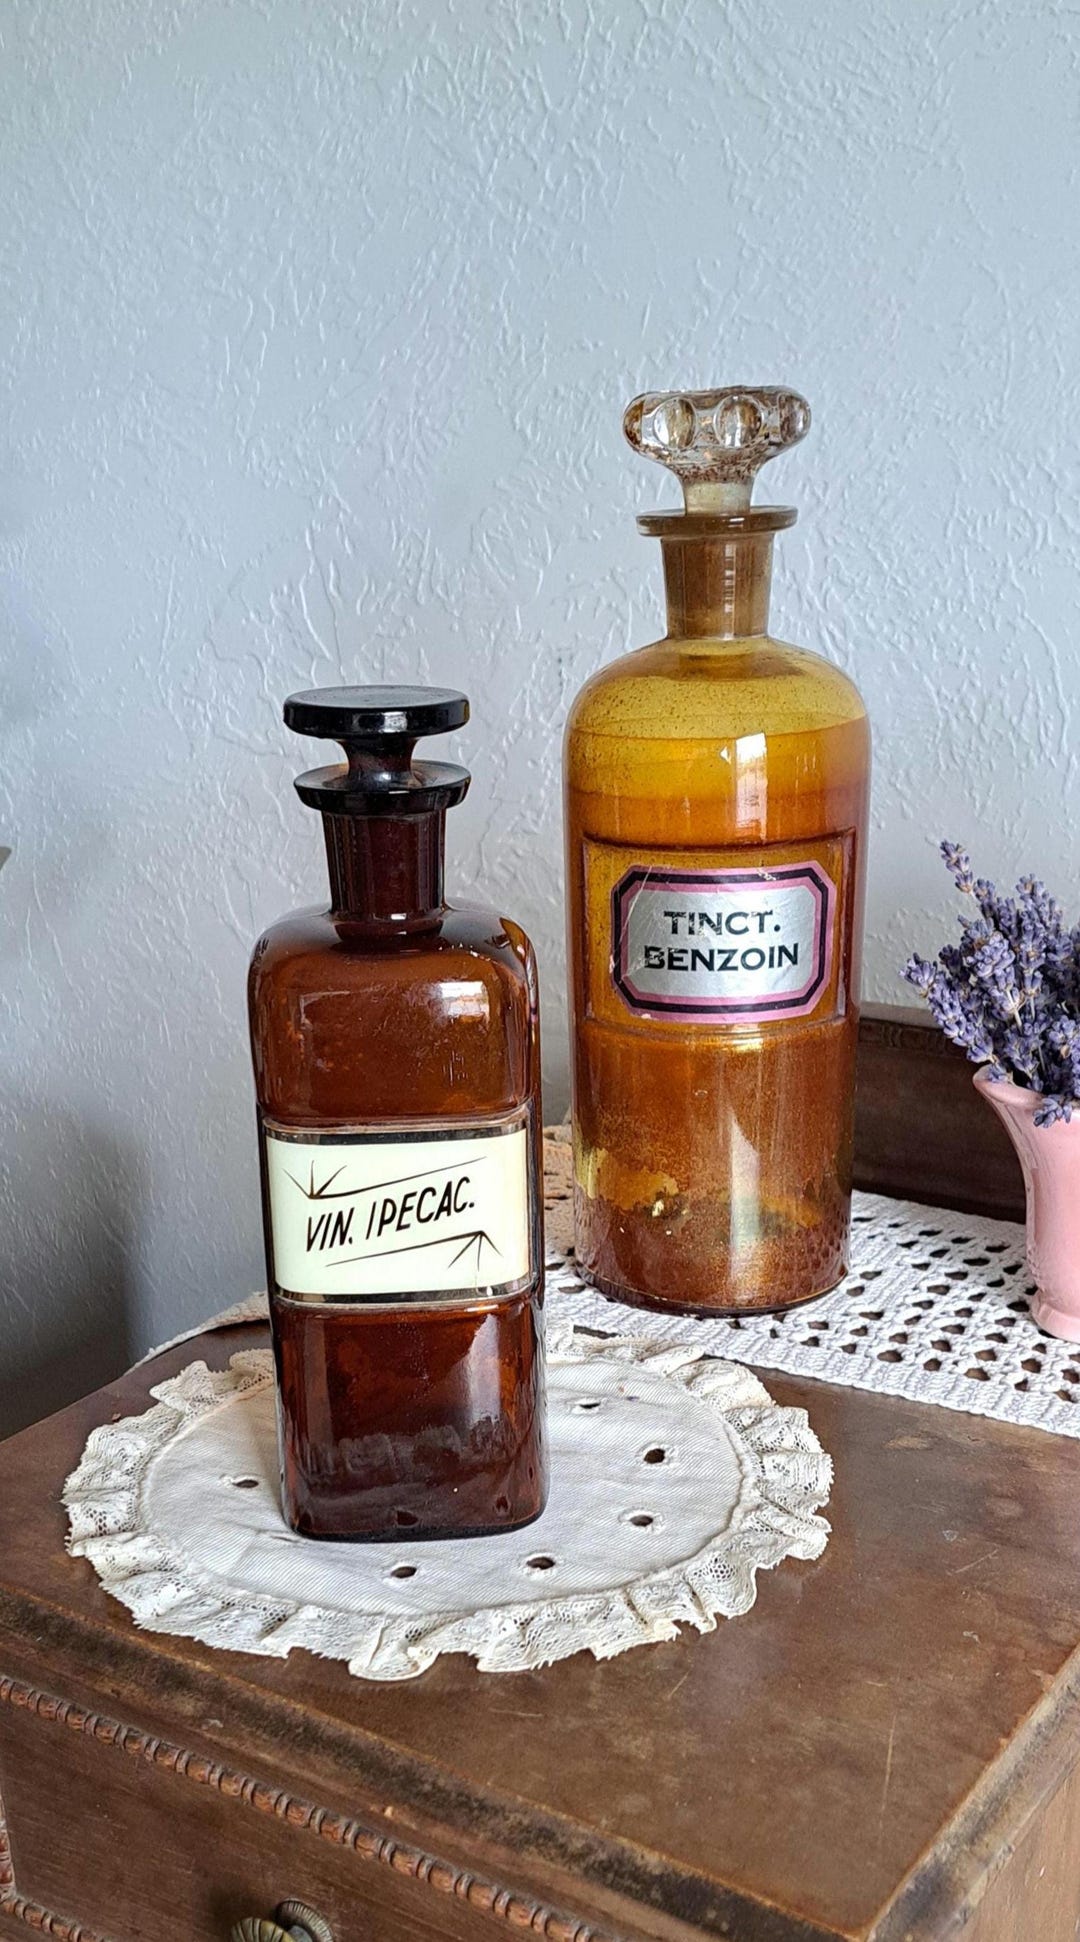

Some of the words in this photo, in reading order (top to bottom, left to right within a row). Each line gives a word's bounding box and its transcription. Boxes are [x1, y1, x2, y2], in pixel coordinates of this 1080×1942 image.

[664, 909, 780, 936] TINCT.
[644, 943, 799, 972] BENZOIN
[306, 1207, 354, 1252] VIN.
[366, 1176, 475, 1240] IPECAC.
